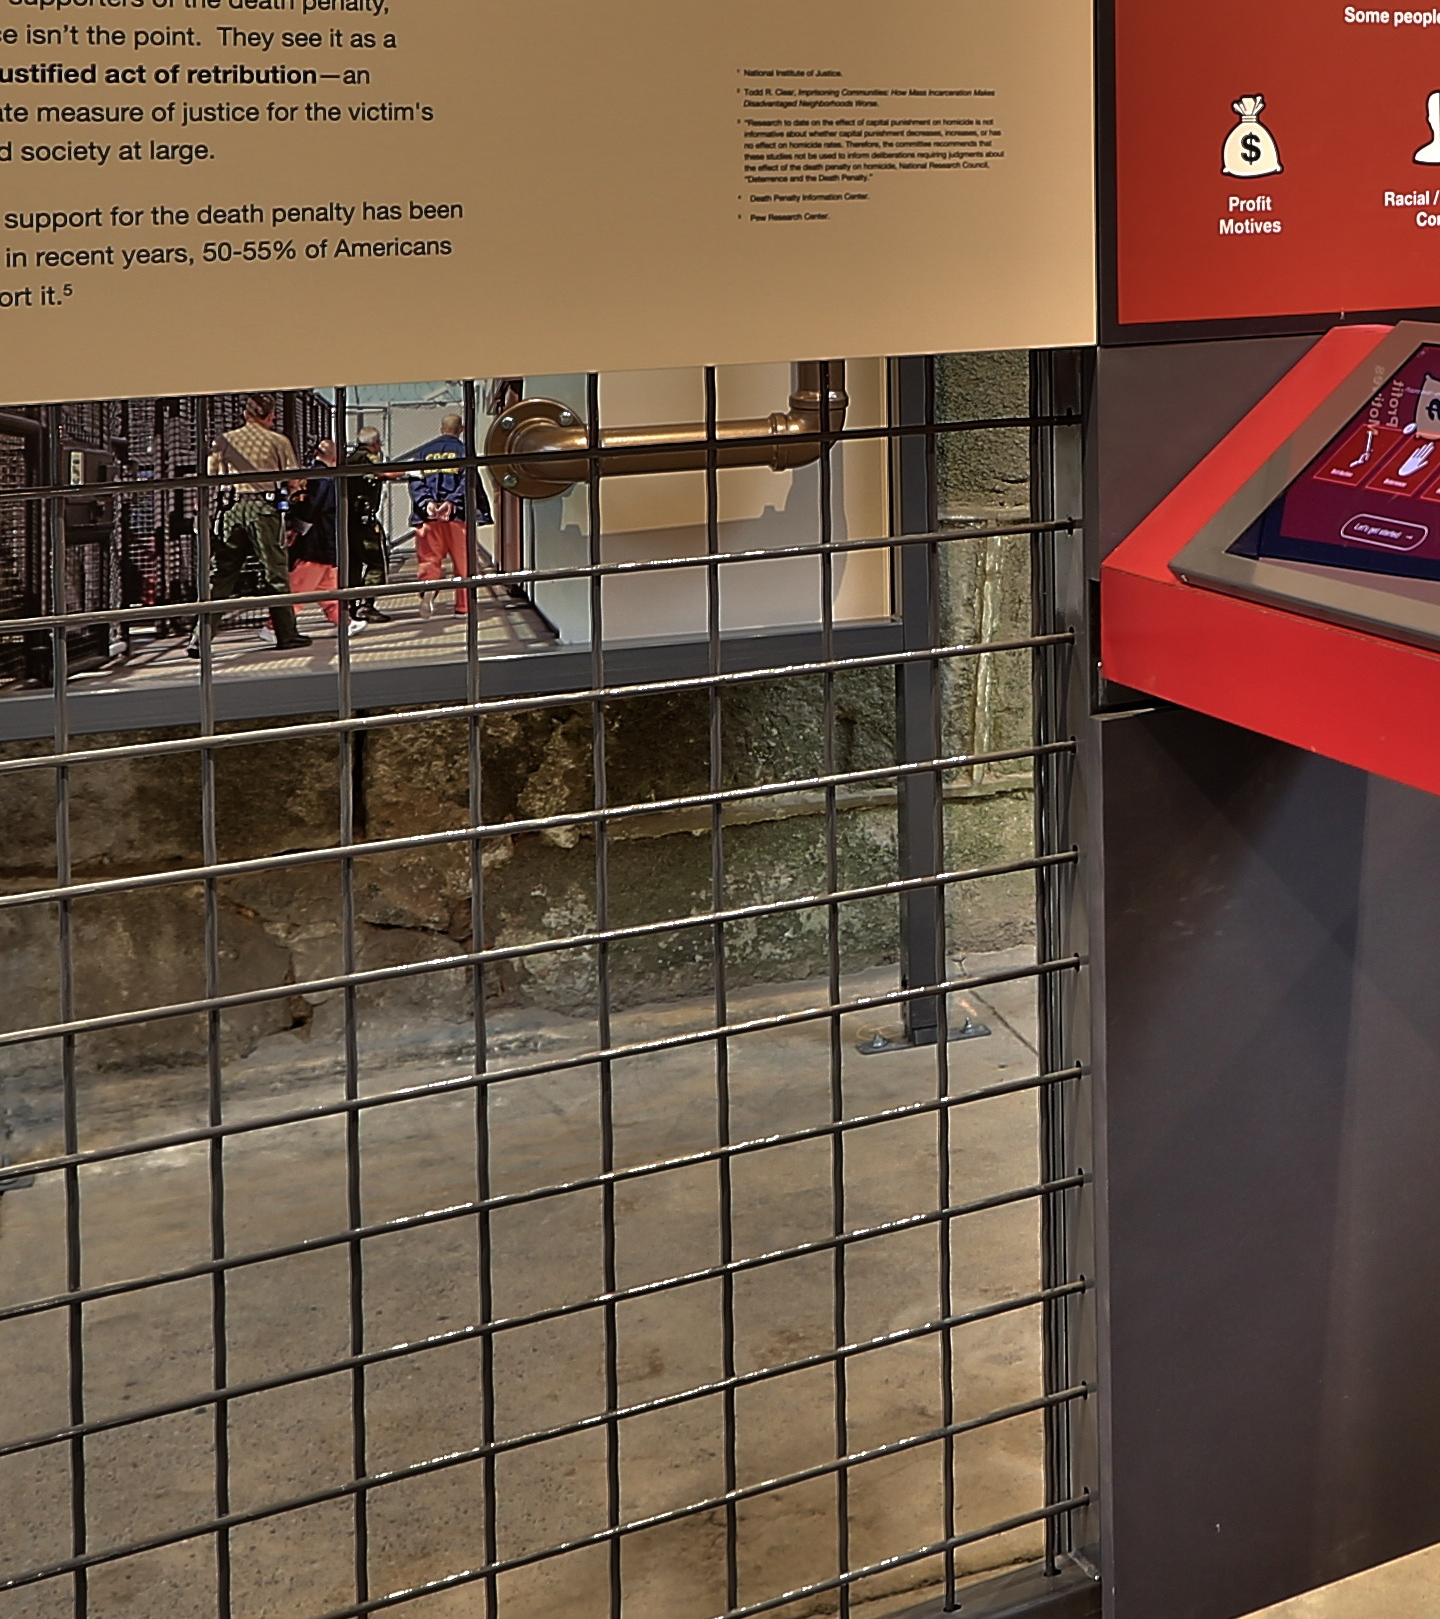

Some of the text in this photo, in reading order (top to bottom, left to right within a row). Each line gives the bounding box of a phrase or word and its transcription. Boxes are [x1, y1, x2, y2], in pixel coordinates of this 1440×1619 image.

[1229, 196, 1271, 211] Profit
[1385, 191, 1429, 206] Racial
[1433, 190, 1439, 205] /
[1220, 218, 1281, 234] Motives
